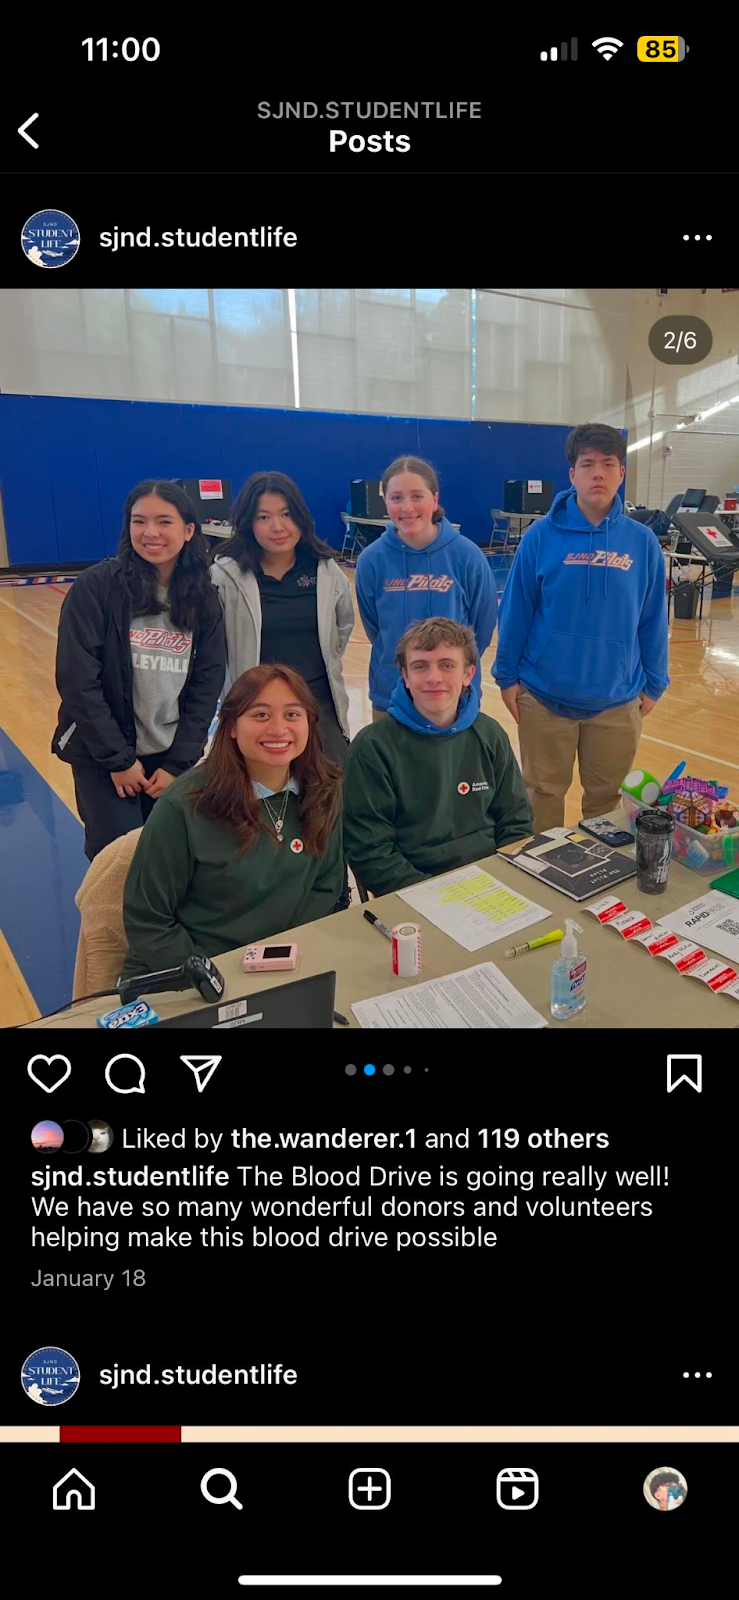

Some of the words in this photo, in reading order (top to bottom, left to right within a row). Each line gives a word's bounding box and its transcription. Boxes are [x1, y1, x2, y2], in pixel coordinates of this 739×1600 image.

[592, 549, 634, 571] Pilots
[407, 574, 455, 593] Pilots
[142, 627, 192, 655] Pilots
